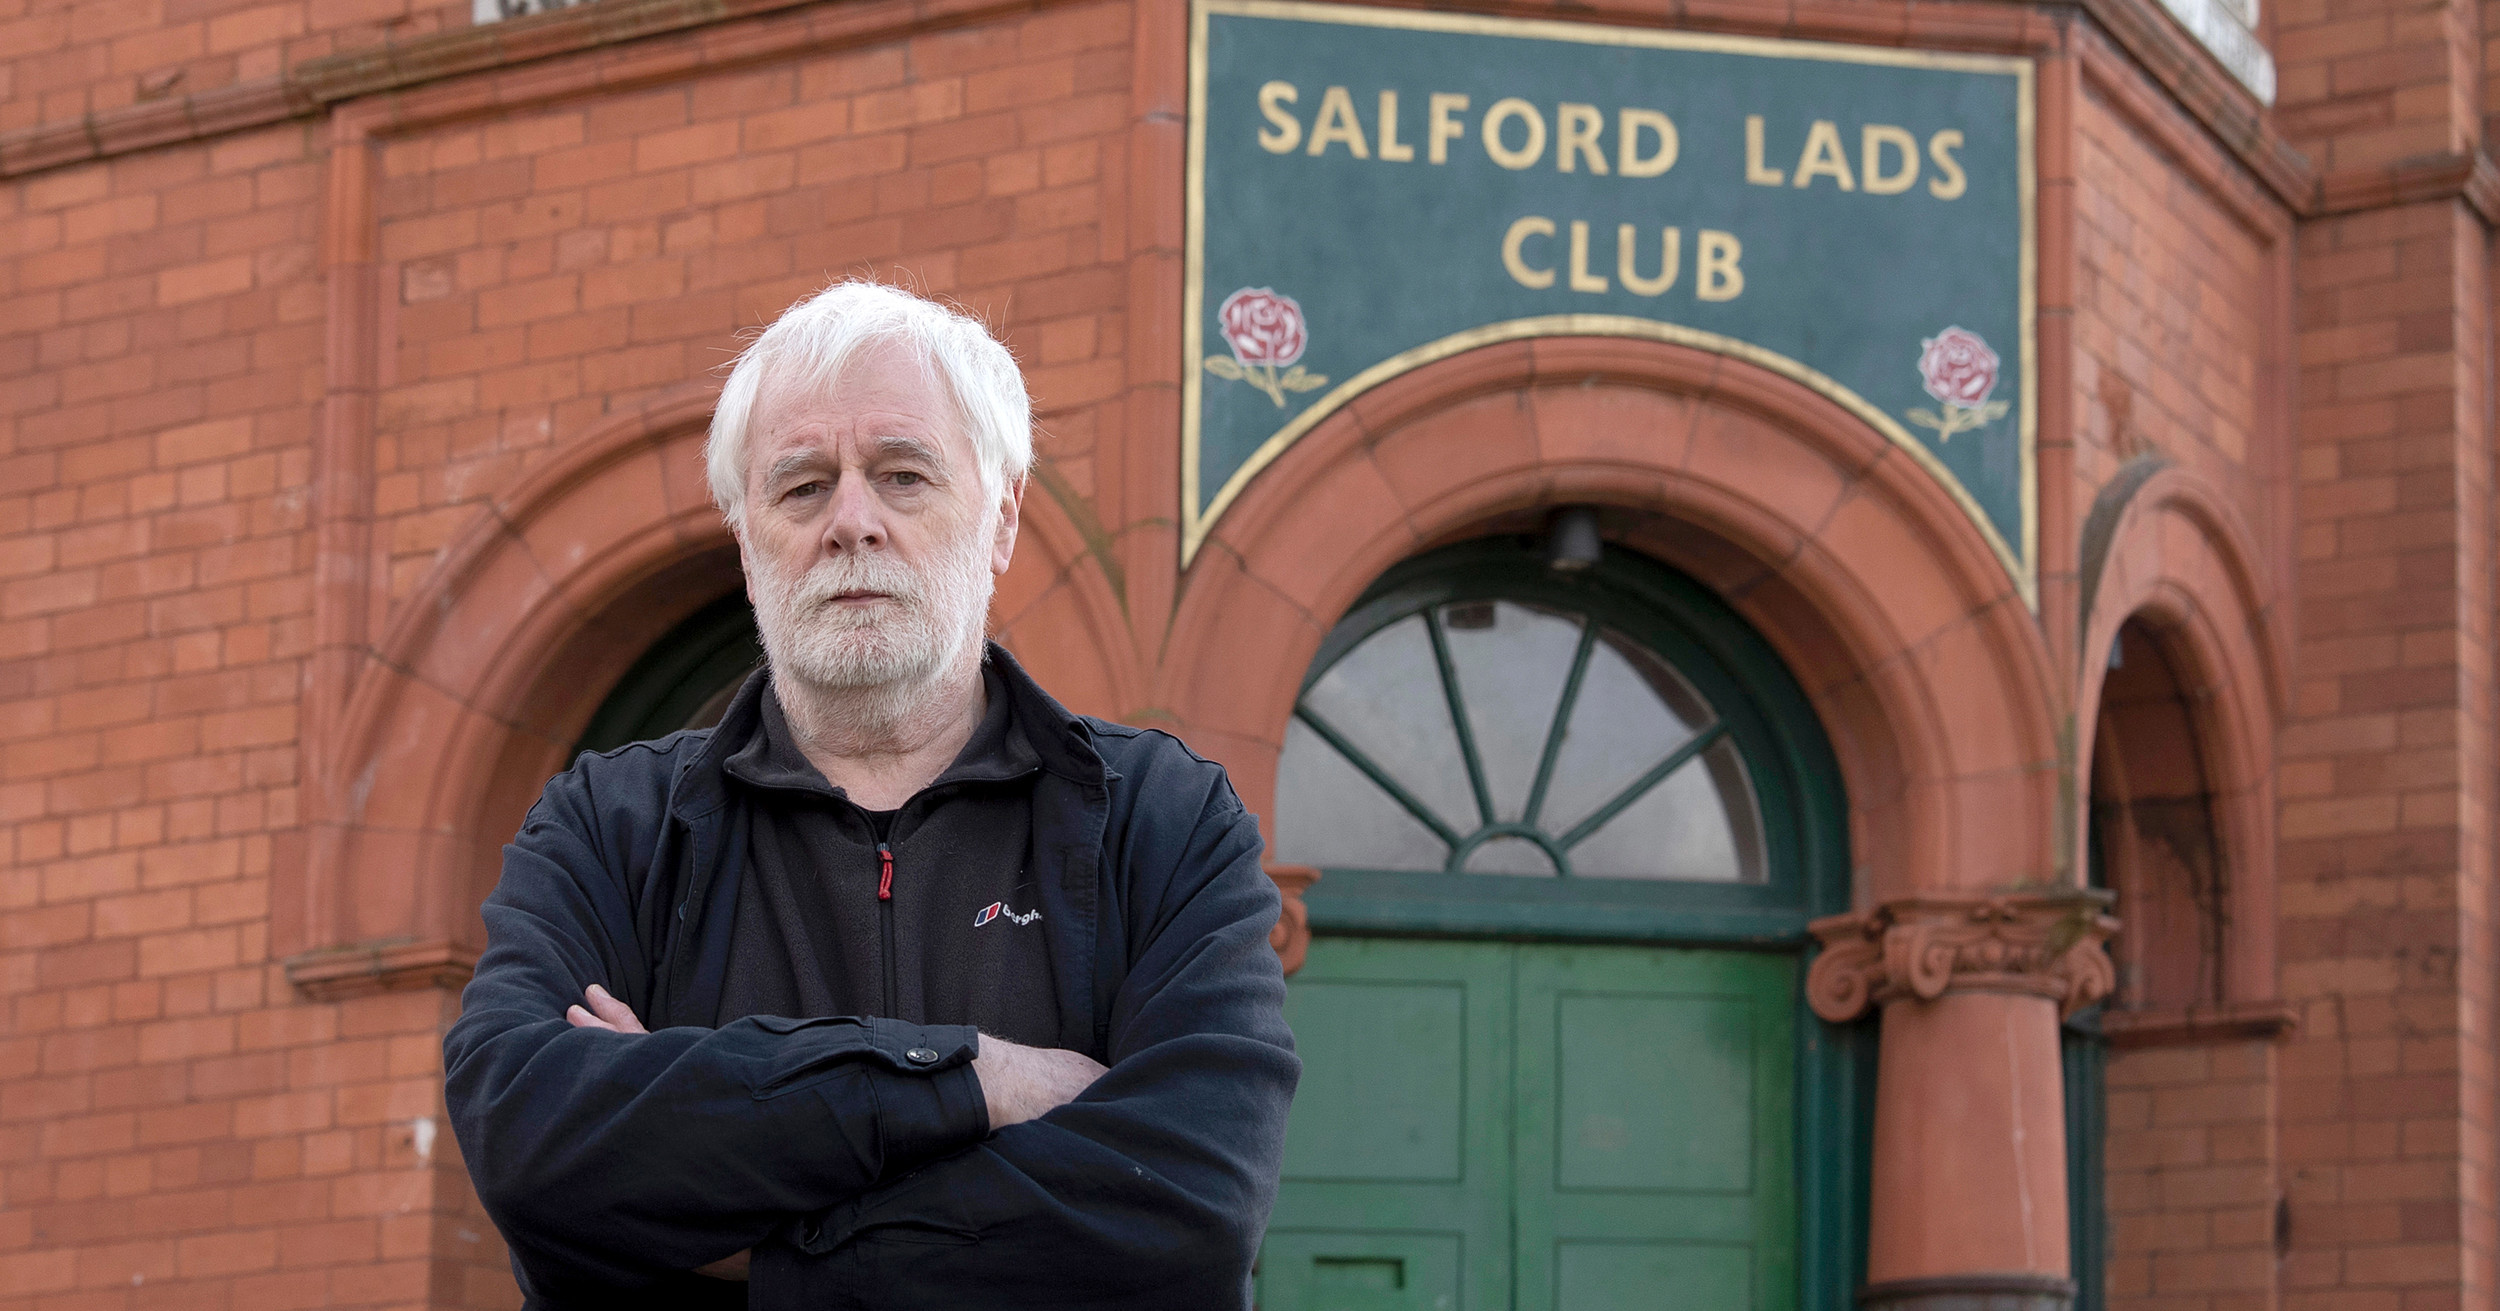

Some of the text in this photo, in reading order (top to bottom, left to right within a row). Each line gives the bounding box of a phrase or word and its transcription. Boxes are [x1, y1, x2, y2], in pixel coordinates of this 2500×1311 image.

[1258, 81, 1967, 201] SALFORD LADS
[1501, 216, 1745, 302] CLUB
